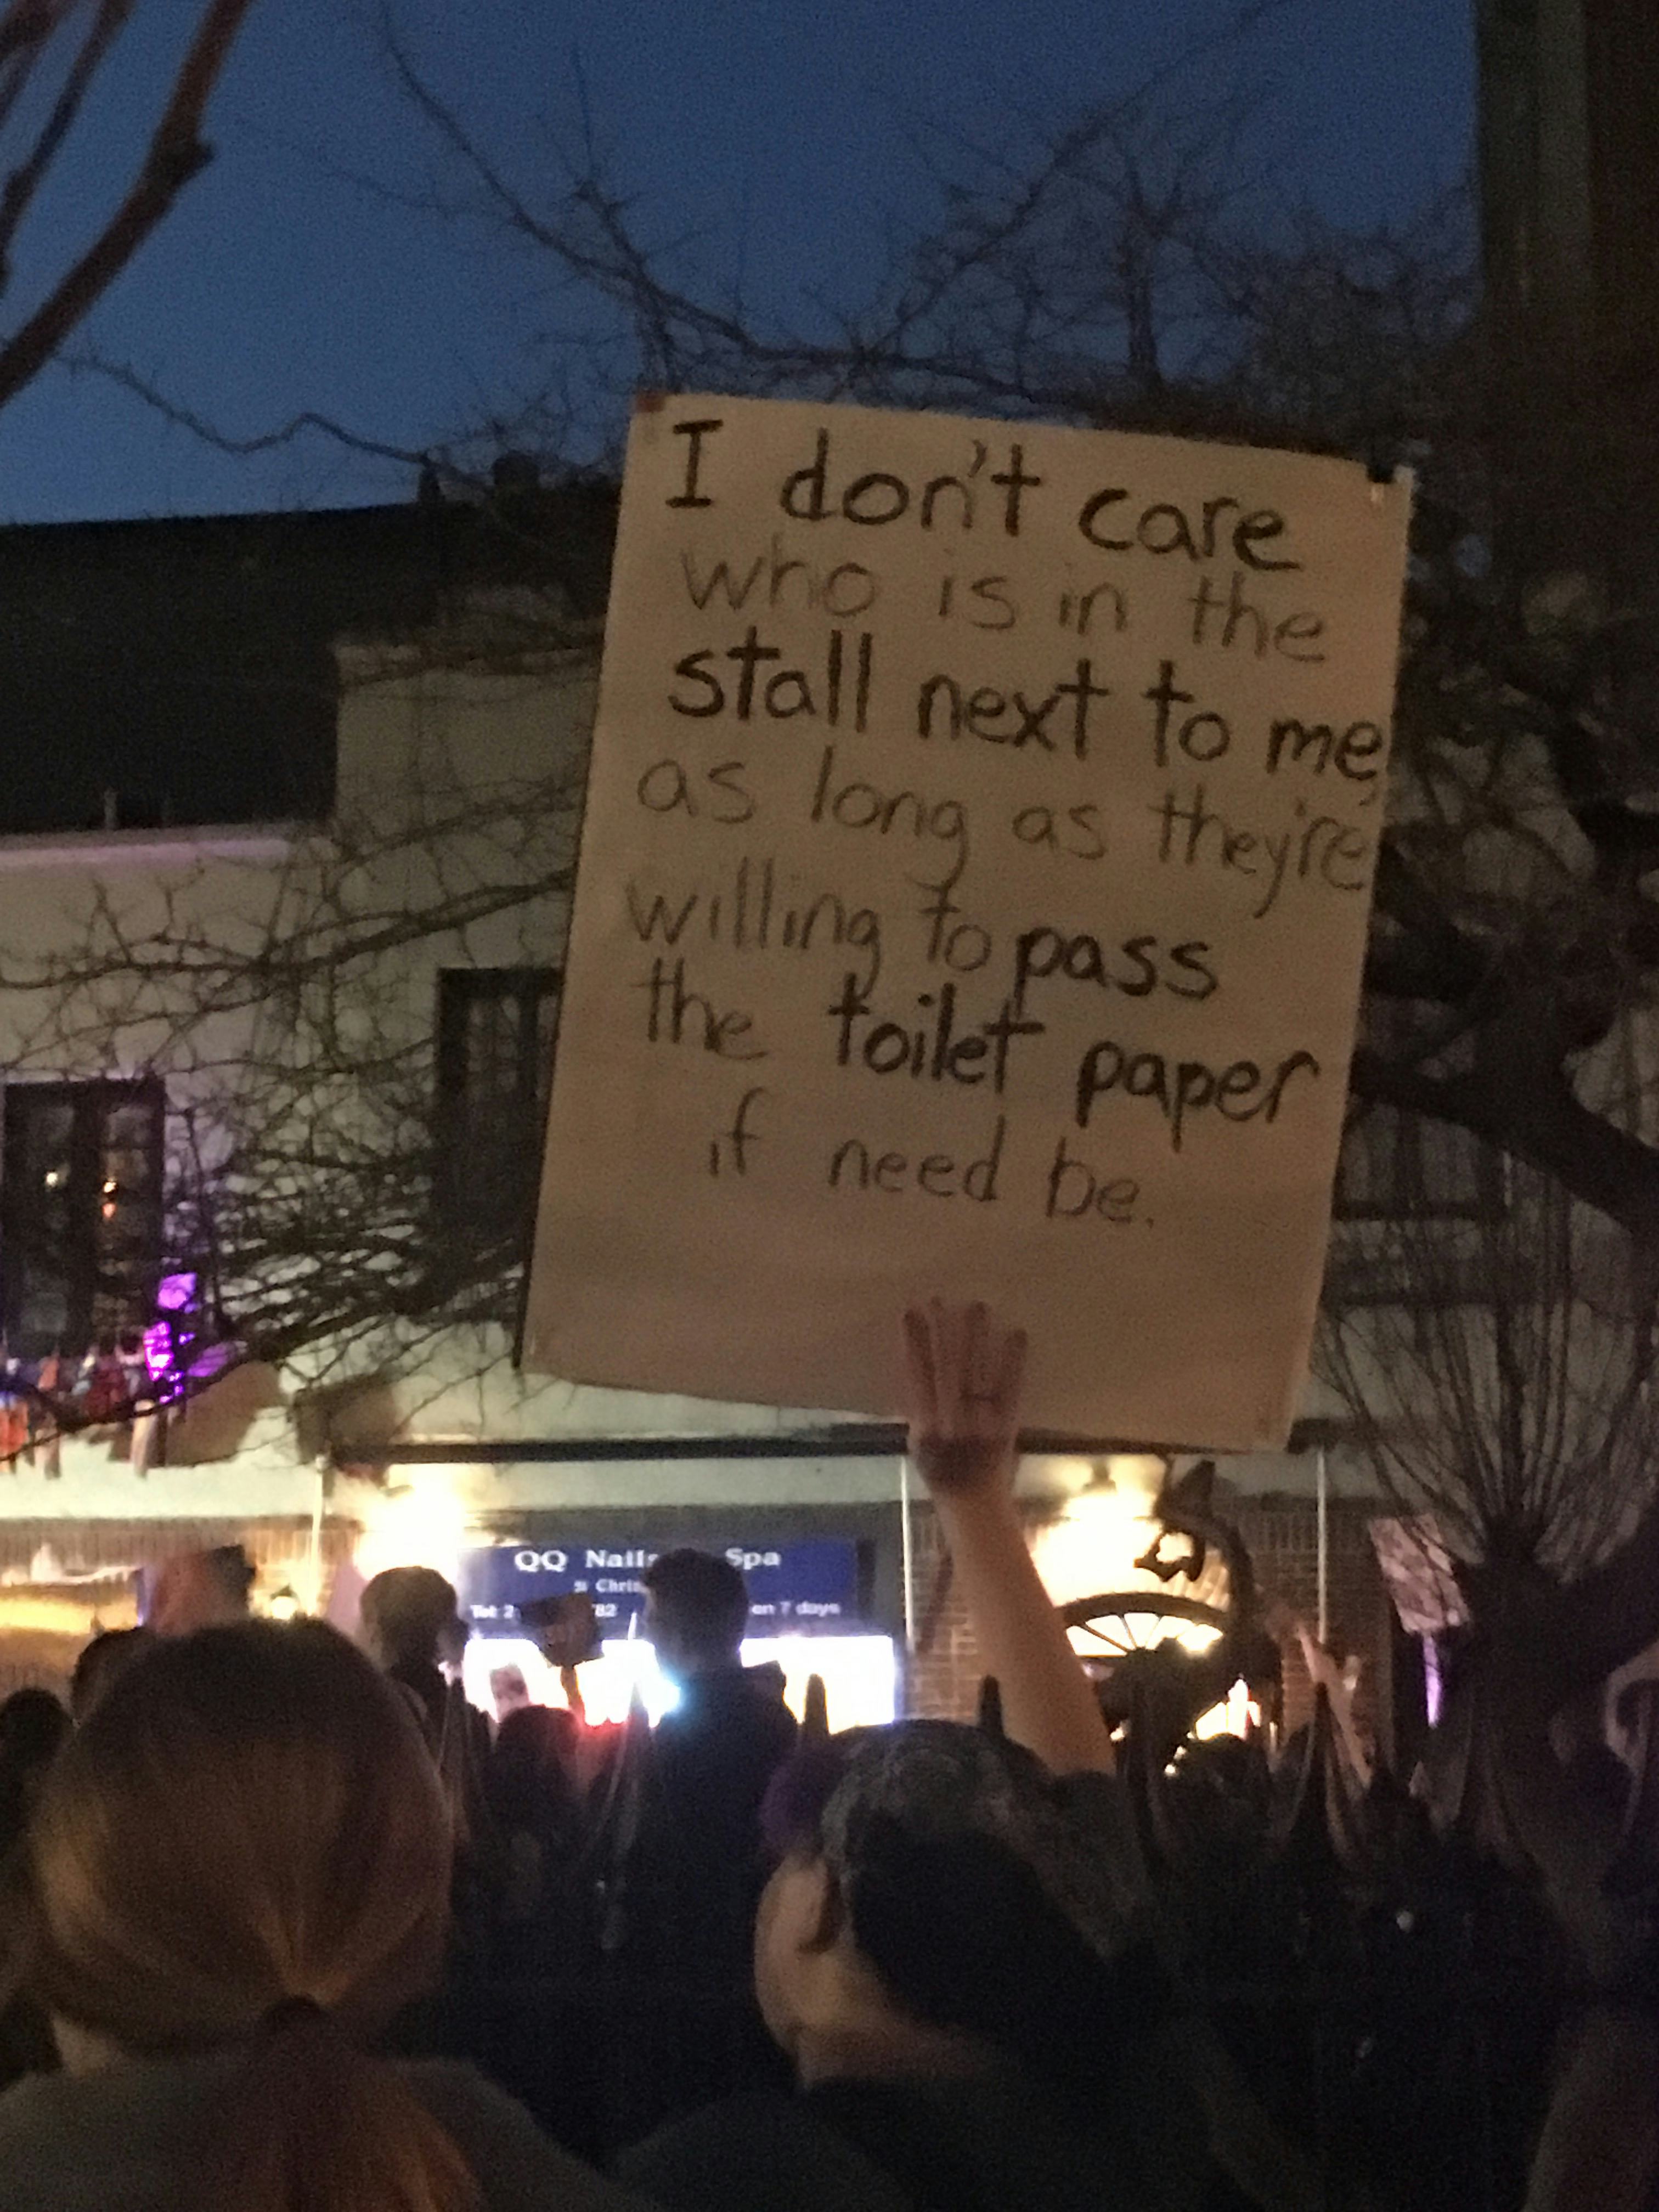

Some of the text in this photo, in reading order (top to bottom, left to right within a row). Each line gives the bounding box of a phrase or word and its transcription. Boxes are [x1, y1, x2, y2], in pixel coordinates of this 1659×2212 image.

[666, 420, 1304, 571] I don't care
[681, 532, 1325, 662] who is in the
[667, 625, 873, 733] stall
[917, 659, 1109, 761] next
[1142, 659, 1231, 768] to
[636, 744, 1368, 920] as long as they're
[624, 856, 1220, 1020] willing to pass
[631, 958, 1321, 1155] the toilet paper
[708, 1087, 766, 1178] if
[828, 1114, 1007, 1203] need
[514, 1550, 568, 1573] QQ
[725, 1547, 782, 1571] Spa
